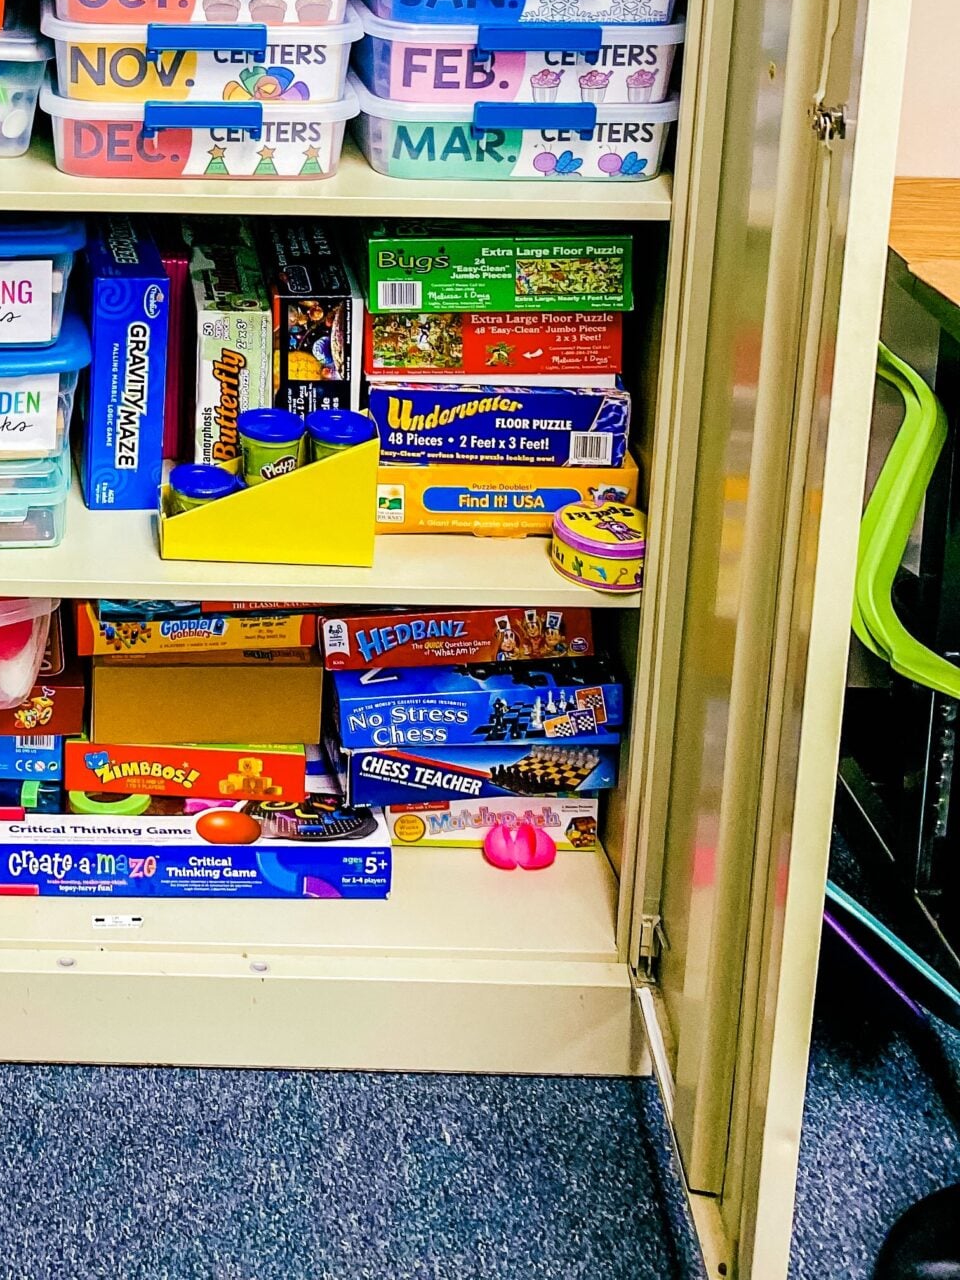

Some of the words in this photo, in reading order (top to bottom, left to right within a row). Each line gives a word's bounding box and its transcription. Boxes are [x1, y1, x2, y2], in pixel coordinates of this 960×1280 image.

[70, 46, 195, 87] NOV.
[402, 47, 509, 91] FEB.
[73, 120, 180, 162] DEC.
[391, 125, 516, 163] MAR.
[378, 250, 450, 274] Bugs
[481, 246, 514, 257] Extra
[516, 247, 550, 259] Large
[552, 246, 582, 256] Floor
[585, 245, 624, 255] Puzzle
[450, 271, 481, 280] Jumbo
[482, 271, 513, 279] Pieces
[203, 322, 213, 336] 50
[471, 314, 503, 324] Extra
[505, 314, 538, 325] Large
[541, 313, 572, 324] Floor
[576, 313, 613, 323] Puzzle
[474, 326, 486, 334] 48
[545, 326, 576, 334] Jumbo
[578, 325, 607, 333] Pieces
[579, 333, 602, 342] Feet!
[111, 342, 120, 373] FALLING
[123, 323, 147, 410] GRAVITY
[109, 373, 119, 404] MARBLE
[106, 404, 114, 426] LOGIC
[213, 348, 246, 462] Butterfly
[387, 395, 523, 432] Underwater
[495, 418, 530, 430] FLOOR
[532, 418, 572, 431] PUZZLE
[104, 426, 113, 447] GAME
[117, 408, 138, 468] MAZE
[388, 432, 404, 445] 48
[407, 433, 443, 446] Pieces
[459, 435, 468, 448] 2
[470, 435, 496, 449] Feet
[498, 439, 506, 449] x
[508, 437, 516, 449] 3
[520, 438, 550, 450] Feet!
[459, 494, 490, 508] Find
[493, 495, 508, 508] It!
[513, 495, 545, 508] USA
[170, 629, 212, 641] Gobblers
[355, 620, 468, 663] HEDBANZ
[411, 642, 423, 650] The
[444, 640, 472, 649] Question
[473, 639, 491, 647] Game
[455, 647, 468, 655] Am
[348, 713, 383, 732] No
[391, 706, 469, 724] Stress
[372, 725, 448, 746] Chess
[95, 761, 200, 789] ZIMBBOS!
[361, 755, 411, 779] CHESS
[413, 766, 483, 795] TEACHER
[9, 825, 66, 834] Critical
[70, 826, 142, 836] Thinking
[146, 827, 191, 835] Game
[426, 806, 497, 835] Match
[189, 856, 232, 867] Critical
[342, 856, 363, 865] ages
[364, 857, 388, 875] 5+
[166, 867, 221, 879] Thinking
[222, 868, 257, 878] Game
[364, 876, 387, 886] players
